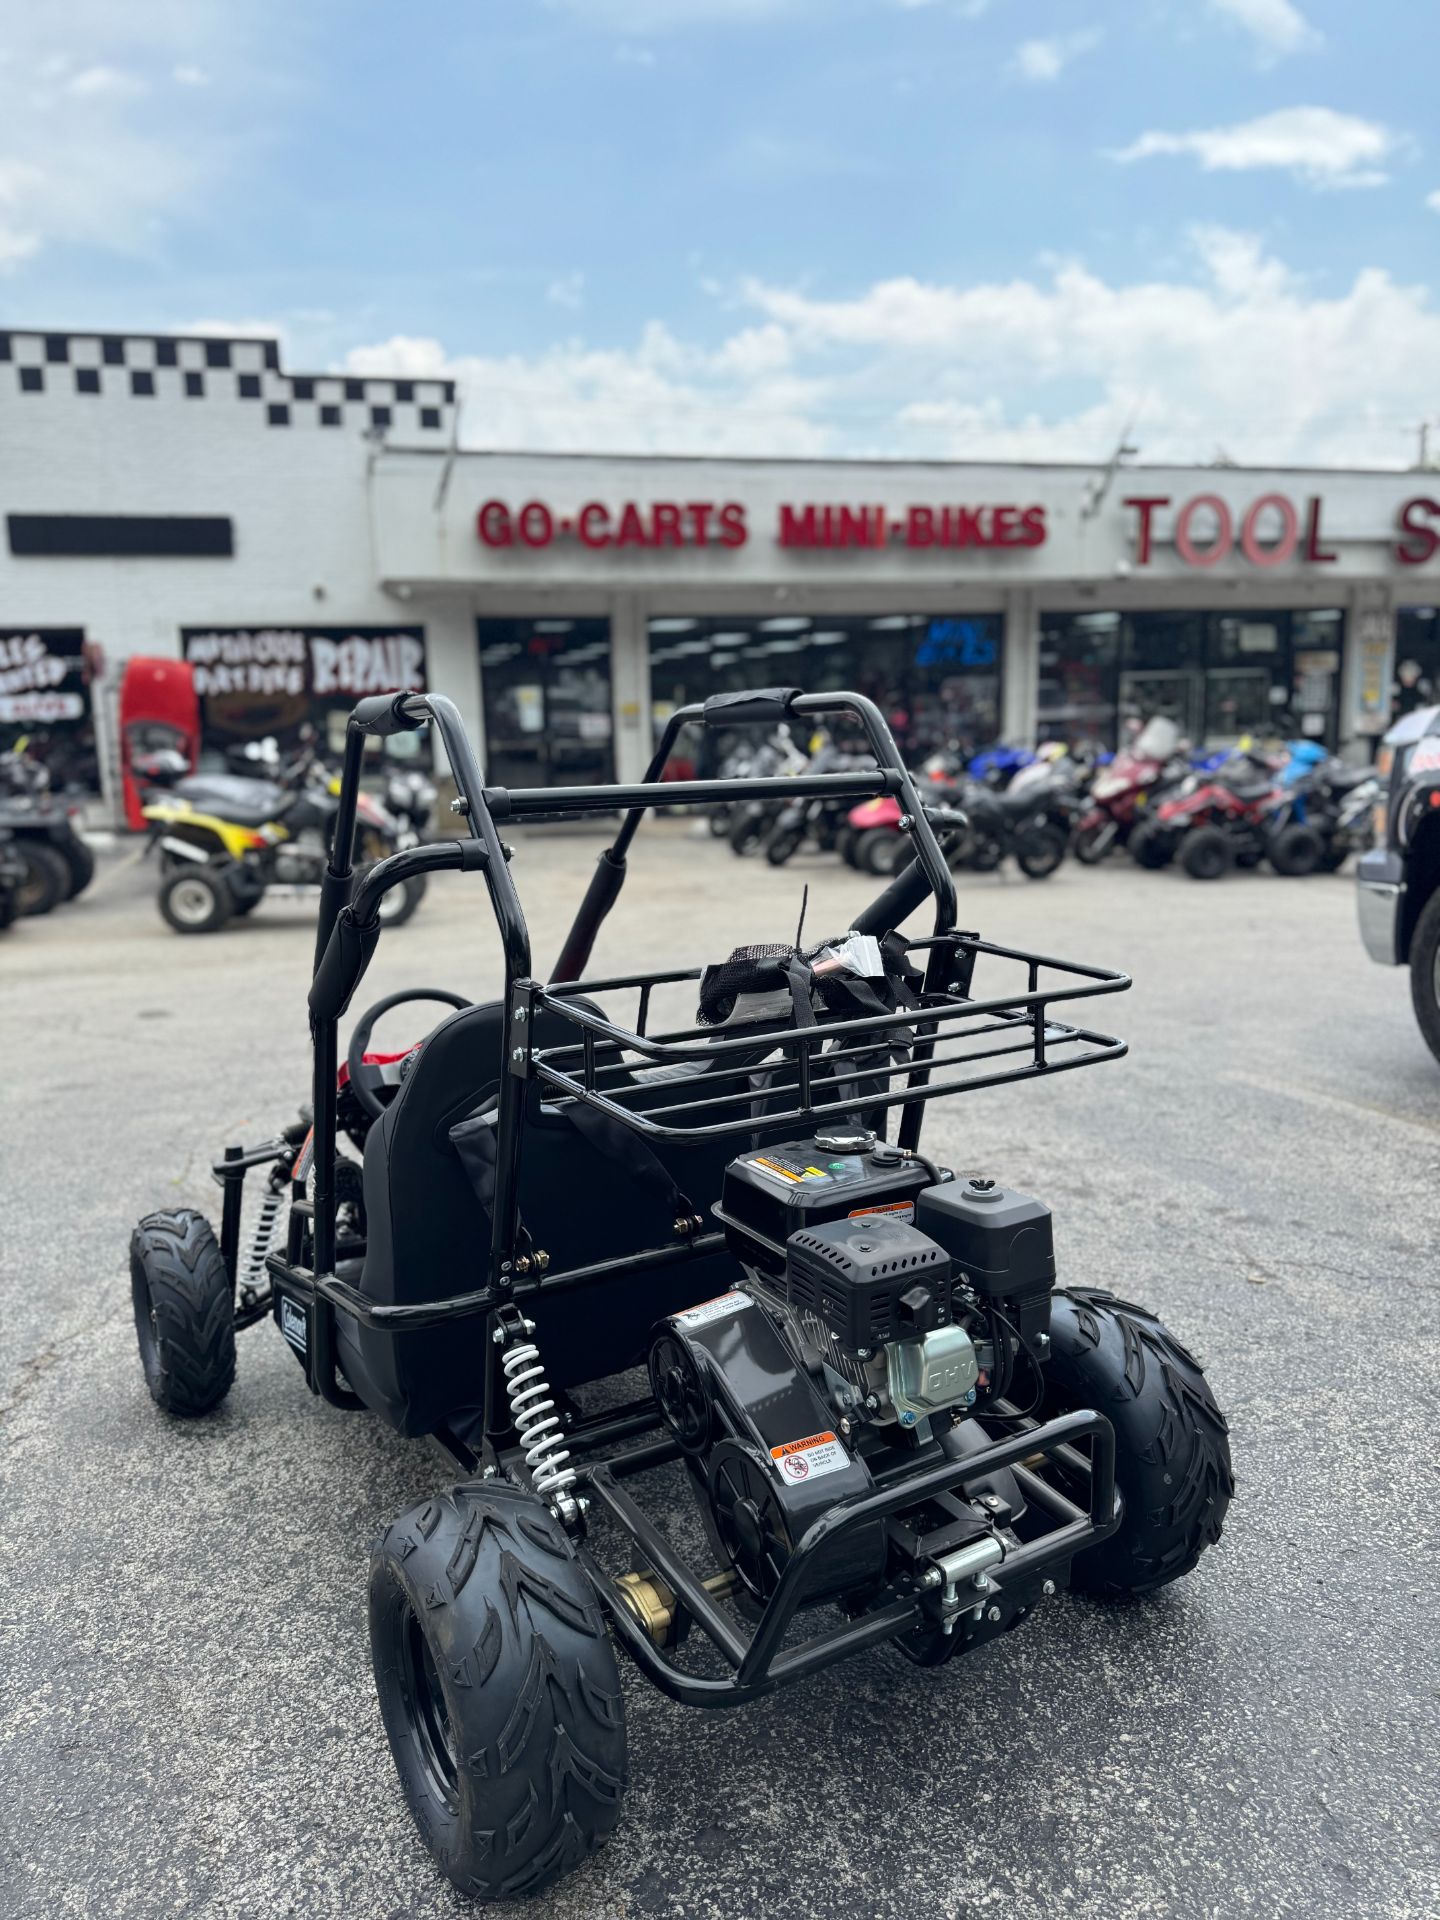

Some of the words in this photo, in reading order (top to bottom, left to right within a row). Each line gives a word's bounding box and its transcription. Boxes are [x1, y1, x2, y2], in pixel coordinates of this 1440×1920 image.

[1122, 492, 1338, 567] TOOL
[309, 633, 424, 695] REPAIR
[928, 1360, 975, 1393] OHV
[789, 1435, 825, 1451] WARNING
[813, 1459, 832, 1468] VEHICLE
